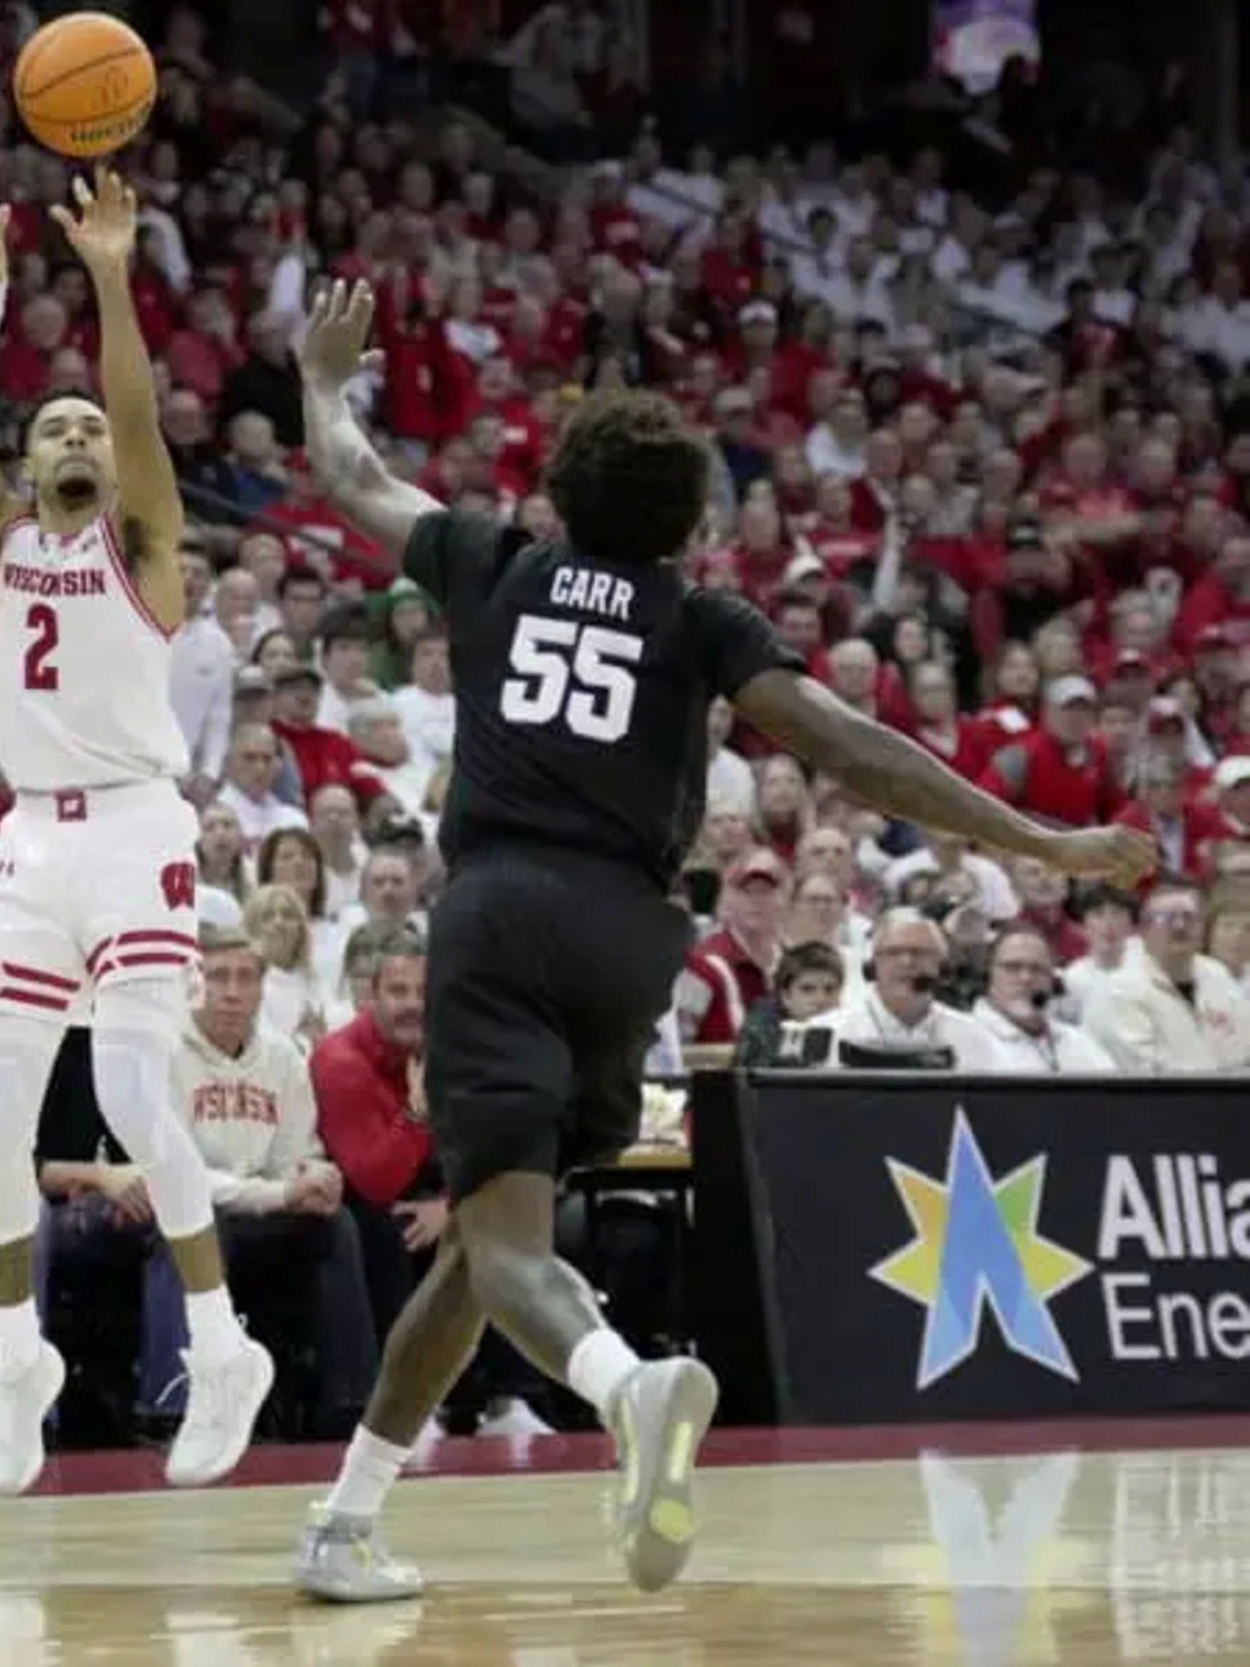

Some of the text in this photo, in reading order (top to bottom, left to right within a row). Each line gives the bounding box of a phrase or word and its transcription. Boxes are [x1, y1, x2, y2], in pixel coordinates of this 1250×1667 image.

[550, 565, 635, 623] CARR
[24, 602, 59, 690] 2
[500, 613, 644, 744] 55
[1101, 1272, 1250, 1360] Ene
